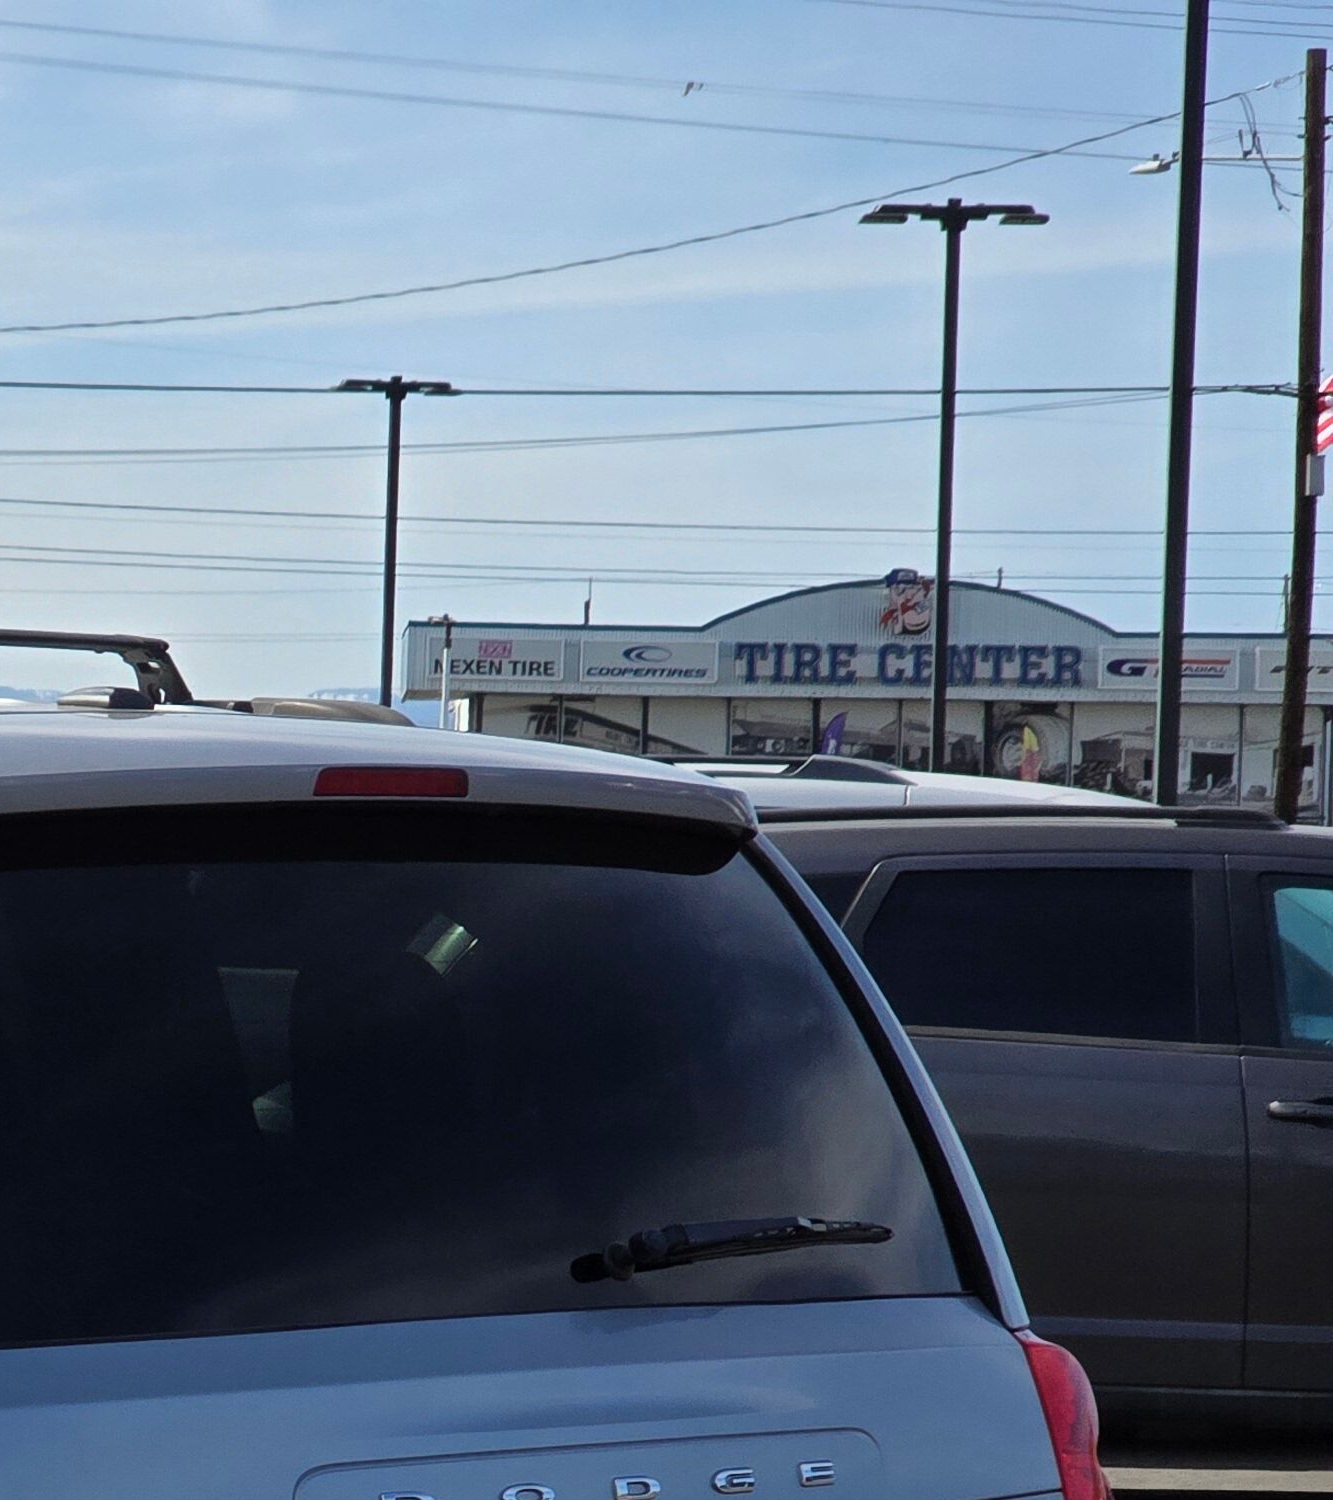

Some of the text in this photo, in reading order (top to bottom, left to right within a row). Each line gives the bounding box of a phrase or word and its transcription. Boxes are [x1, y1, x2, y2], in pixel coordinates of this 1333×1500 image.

[508, 660, 556, 677] TIRE
[735, 642, 1083, 687] TIRE CENTER
